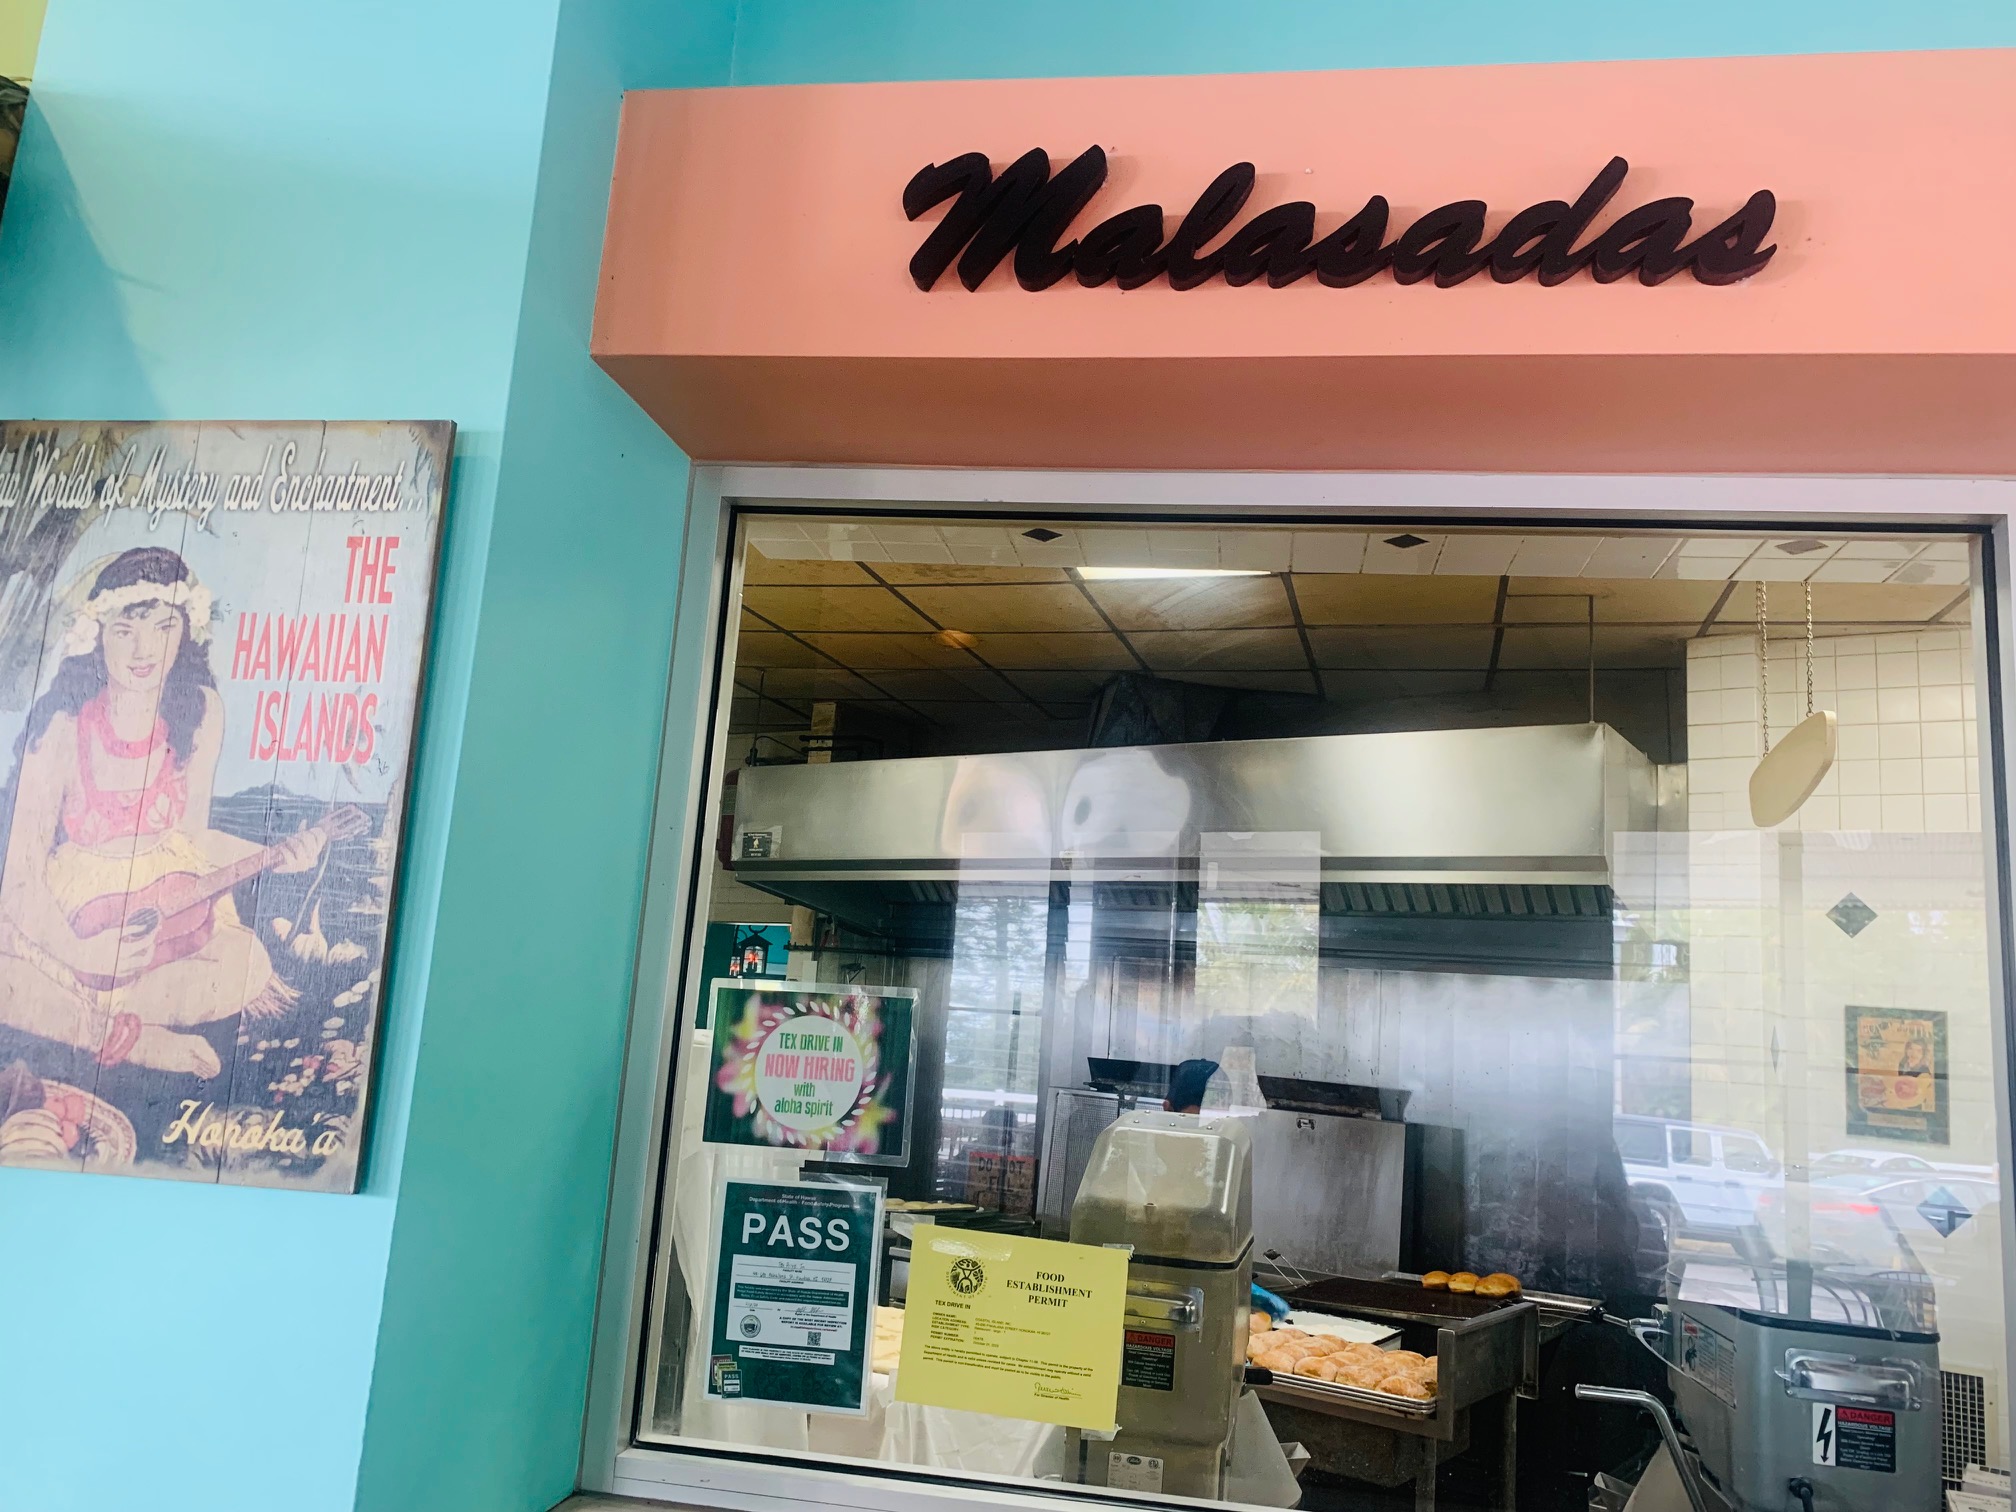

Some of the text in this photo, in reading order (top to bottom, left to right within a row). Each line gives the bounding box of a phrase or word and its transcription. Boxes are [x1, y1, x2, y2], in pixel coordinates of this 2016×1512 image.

[902, 144, 1778, 292] Malasadas
[23, 442, 96, 509] Worlds
[99, 443, 136, 528] of
[130, 444, 220, 531] Mystery
[224, 444, 273, 511] and
[344, 536, 400, 604] THE
[230, 612, 389, 684] HAWAIIAN
[249, 690, 378, 765] ISLANDS
[779, 1032, 844, 1053] TEX DRIVE IN
[764, 1053, 855, 1083] NOW HIRING
[794, 1081, 816, 1098] with
[774, 1097, 833, 1118] aloha spirit
[742, 1212, 850, 1252] PASS
[1036, 1271, 1065, 1283] FOOD
[1006, 1279, 1093, 1299] ESTABLISHMENT
[946, 1301, 964, 1309] DRIVE
[1028, 1294, 1069, 1308] PERMIT
[1850, 1410, 1891, 1424] DANGER
